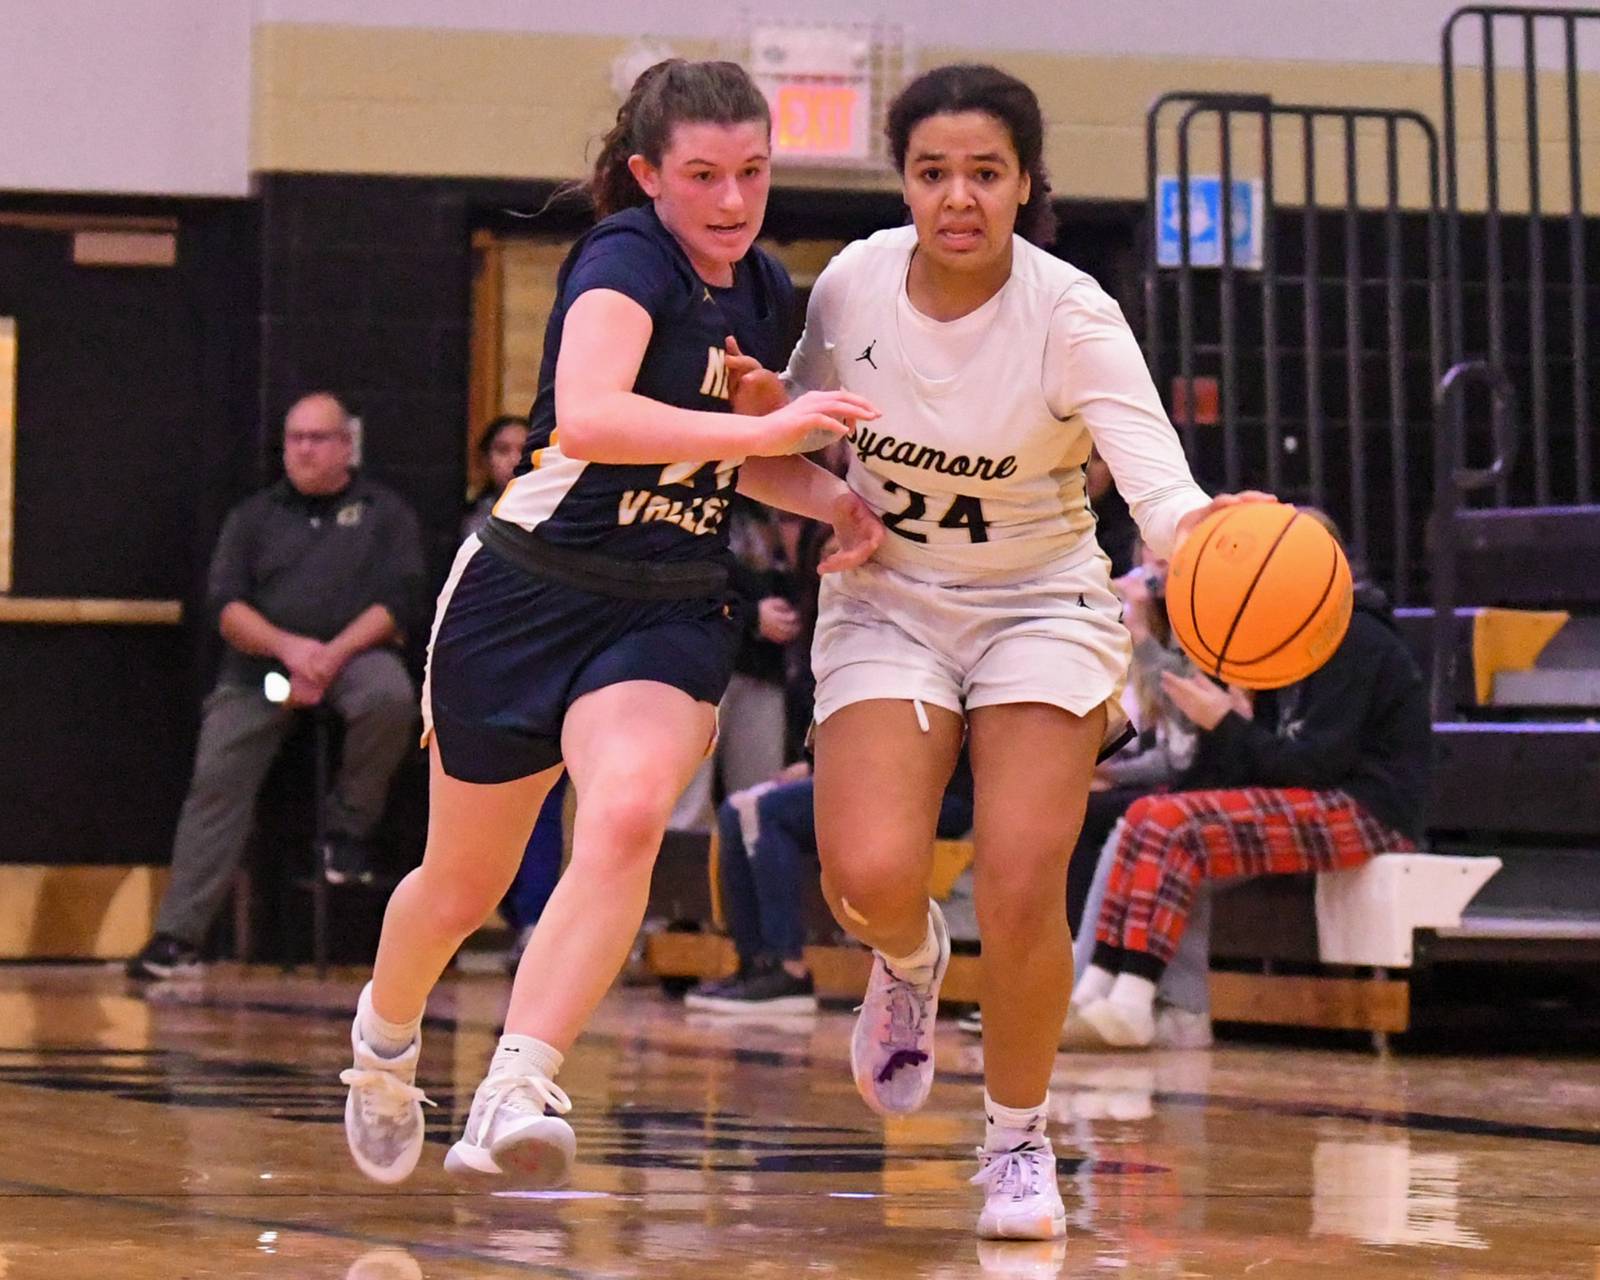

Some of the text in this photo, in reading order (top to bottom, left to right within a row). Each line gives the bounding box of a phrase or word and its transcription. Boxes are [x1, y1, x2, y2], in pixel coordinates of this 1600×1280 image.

[778, 86, 856, 147] EXIT
[617, 490, 729, 536] VALLE
[881, 480, 990, 544] 24
